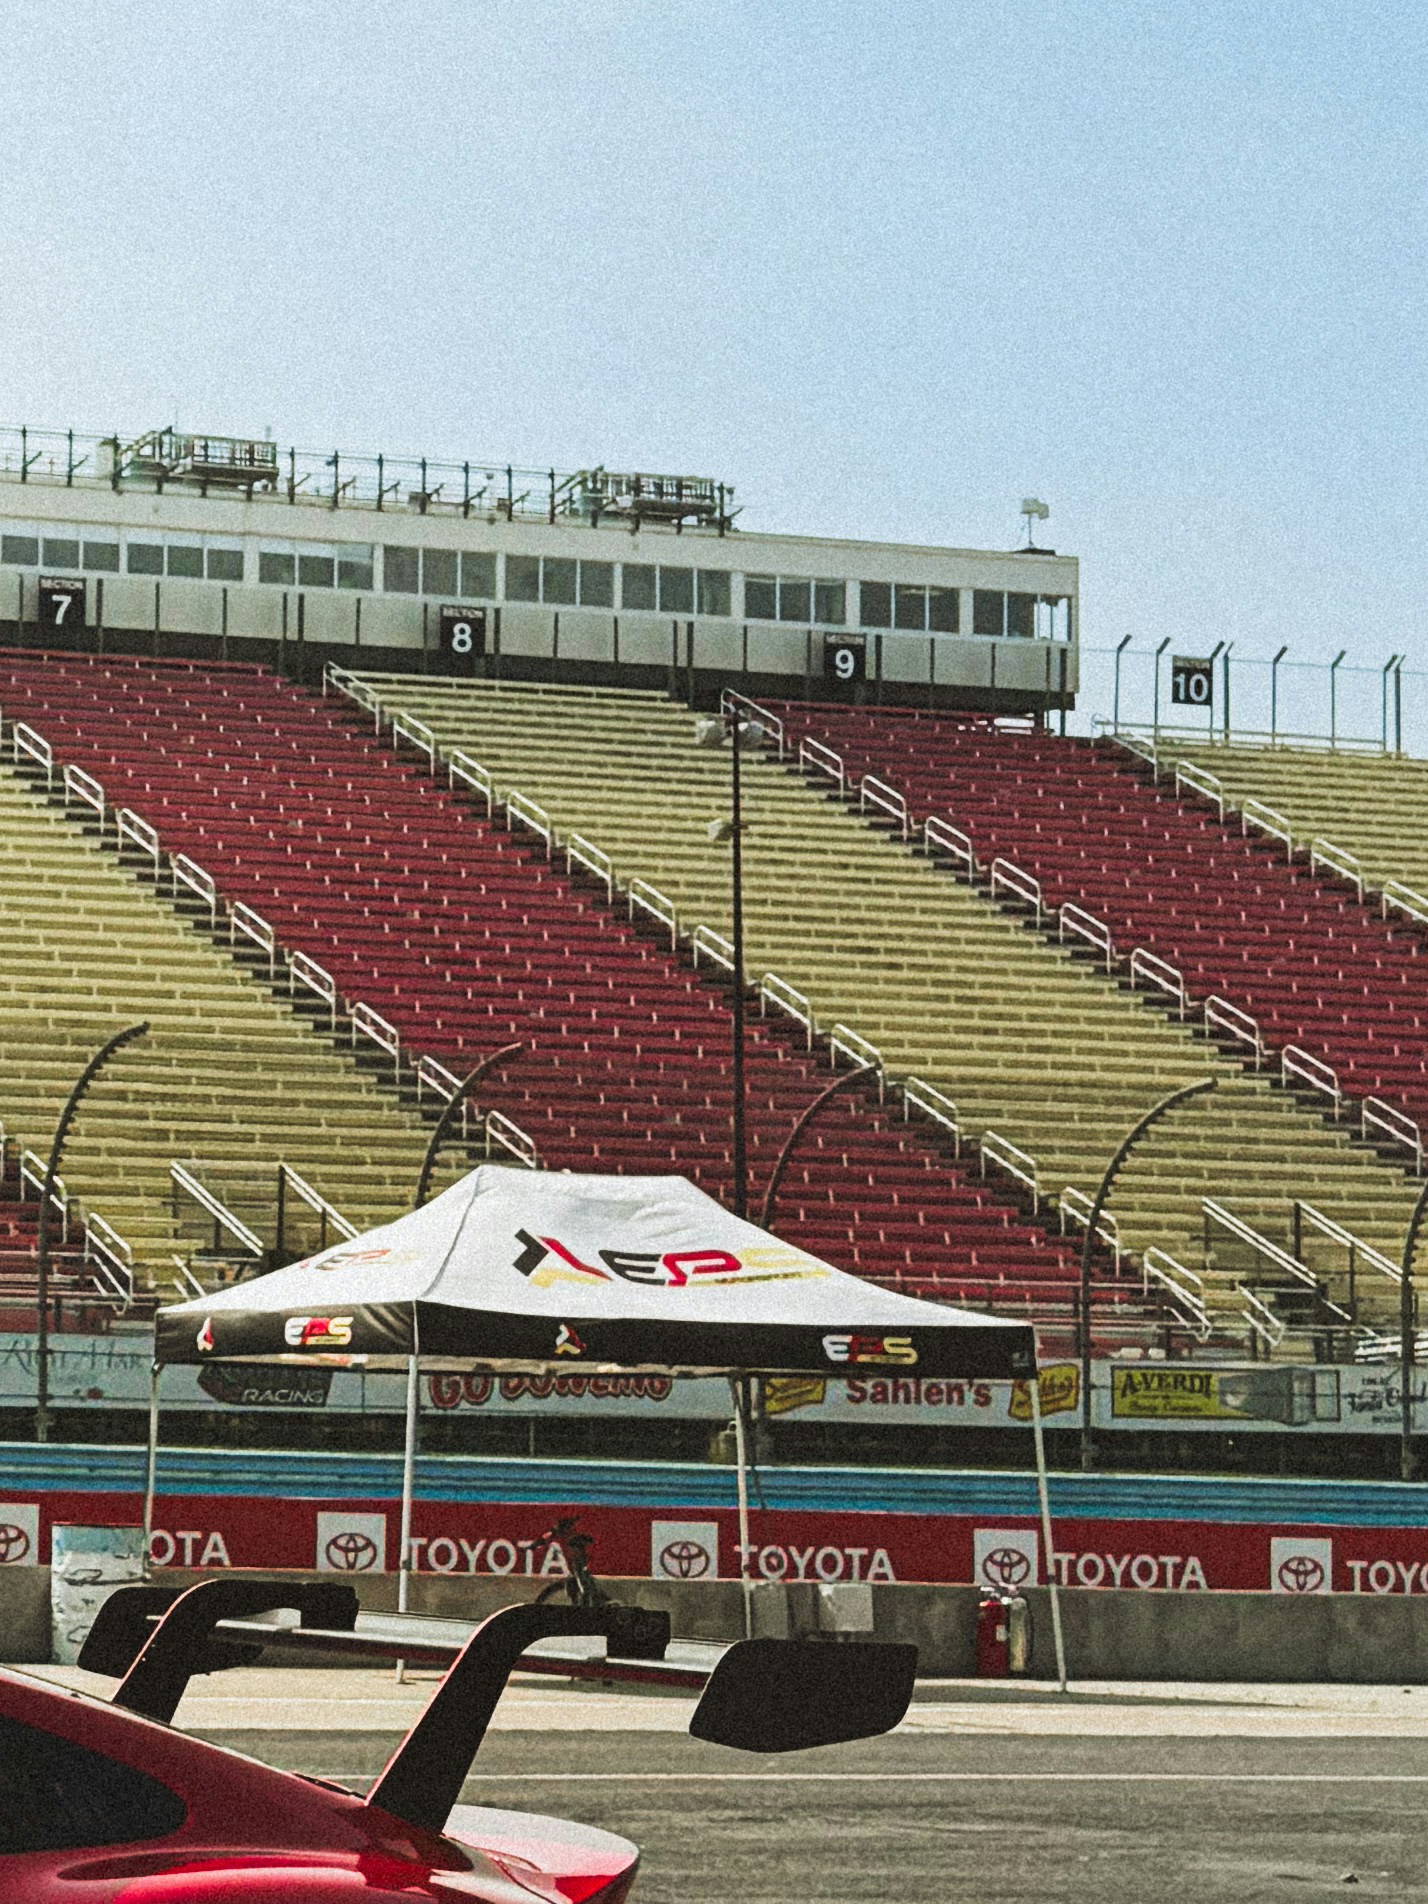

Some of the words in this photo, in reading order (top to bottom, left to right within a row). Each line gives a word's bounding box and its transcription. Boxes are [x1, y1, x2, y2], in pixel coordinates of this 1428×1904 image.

[51, 595, 72, 625] 7
[452, 622, 473, 653] 8
[835, 649, 855, 679] 9
[1173, 673, 1209, 702] 10
[285, 1316, 354, 1346] EPS
[822, 1334, 919, 1365] EPS
[243, 1388, 326, 1404] RACING
[149, 1529, 232, 1567] OTA
[408, 1537, 571, 1576] TOYOTA
[734, 1544, 896, 1582] TOYOTA
[1052, 1552, 1209, 1591] TOYOTA
